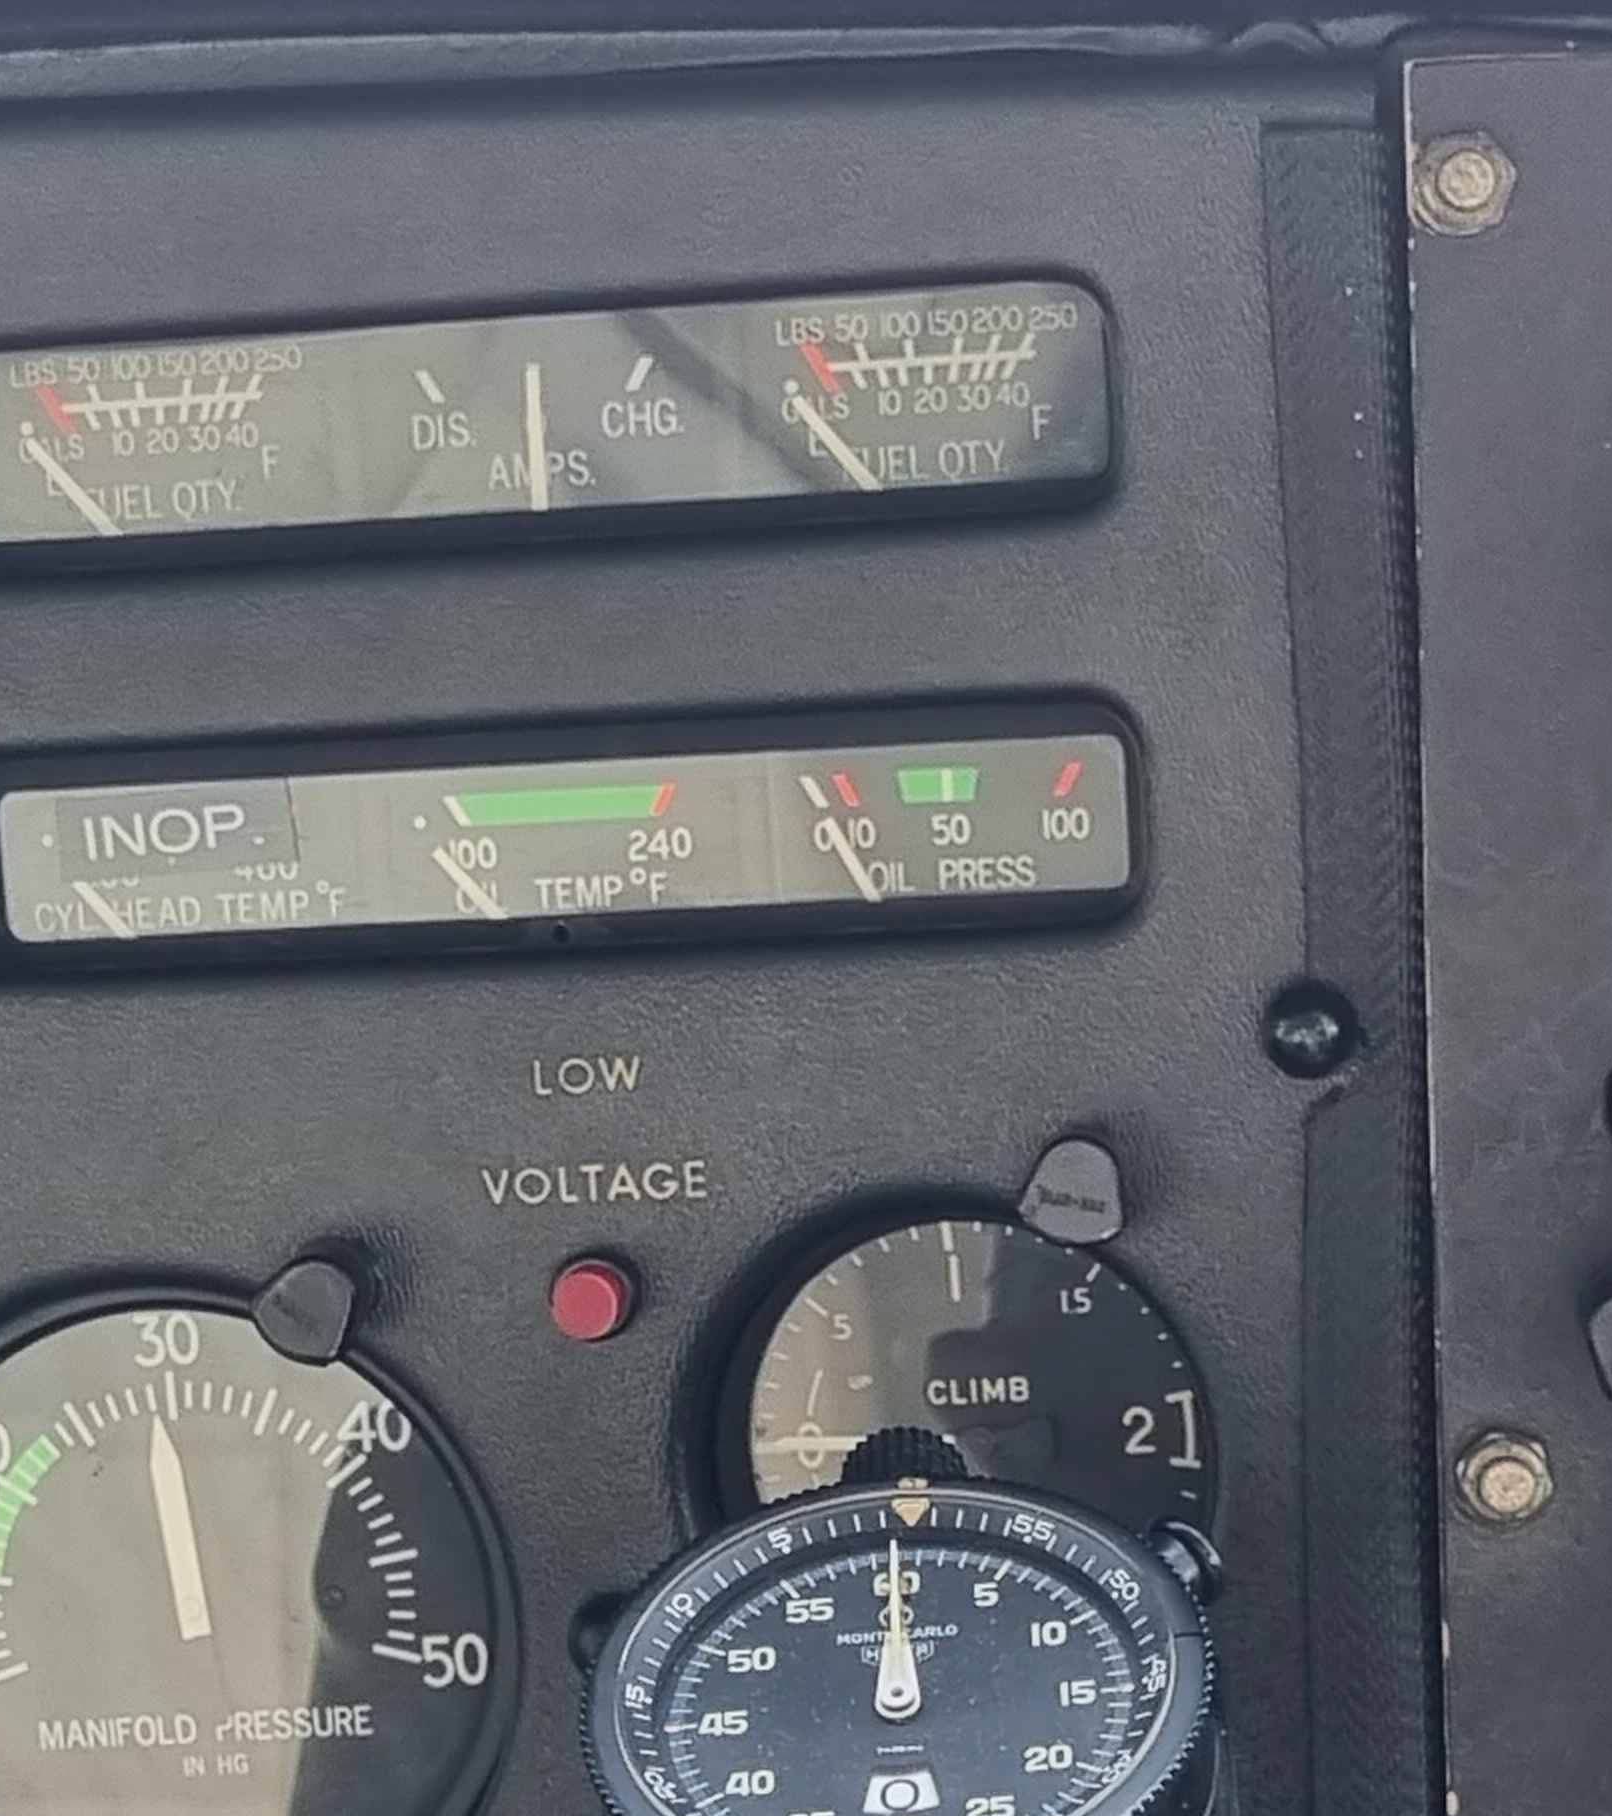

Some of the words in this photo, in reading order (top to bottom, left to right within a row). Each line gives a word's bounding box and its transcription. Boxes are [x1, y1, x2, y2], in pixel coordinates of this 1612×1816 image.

[83, 803, 264, 861] INOP.
[1041, 808, 1089, 841] 100
[628, 827, 691, 863] 240
[938, 856, 1035, 891] PRESS
[535, 878, 622, 909] TEMP
[532, 1056, 643, 1096] LOW
[481, 1160, 707, 1205] VOLTAGE
[133, 1312, 199, 1368] 30
[927, 1376, 1030, 1404] CLIMB
[785, 1598, 834, 1622] 55
[422, 1634, 488, 1686] 50
[38, 1714, 197, 1751] MANIFOLD
[697, 1711, 748, 1736] 45
[1023, 1746, 1073, 1772] 20
